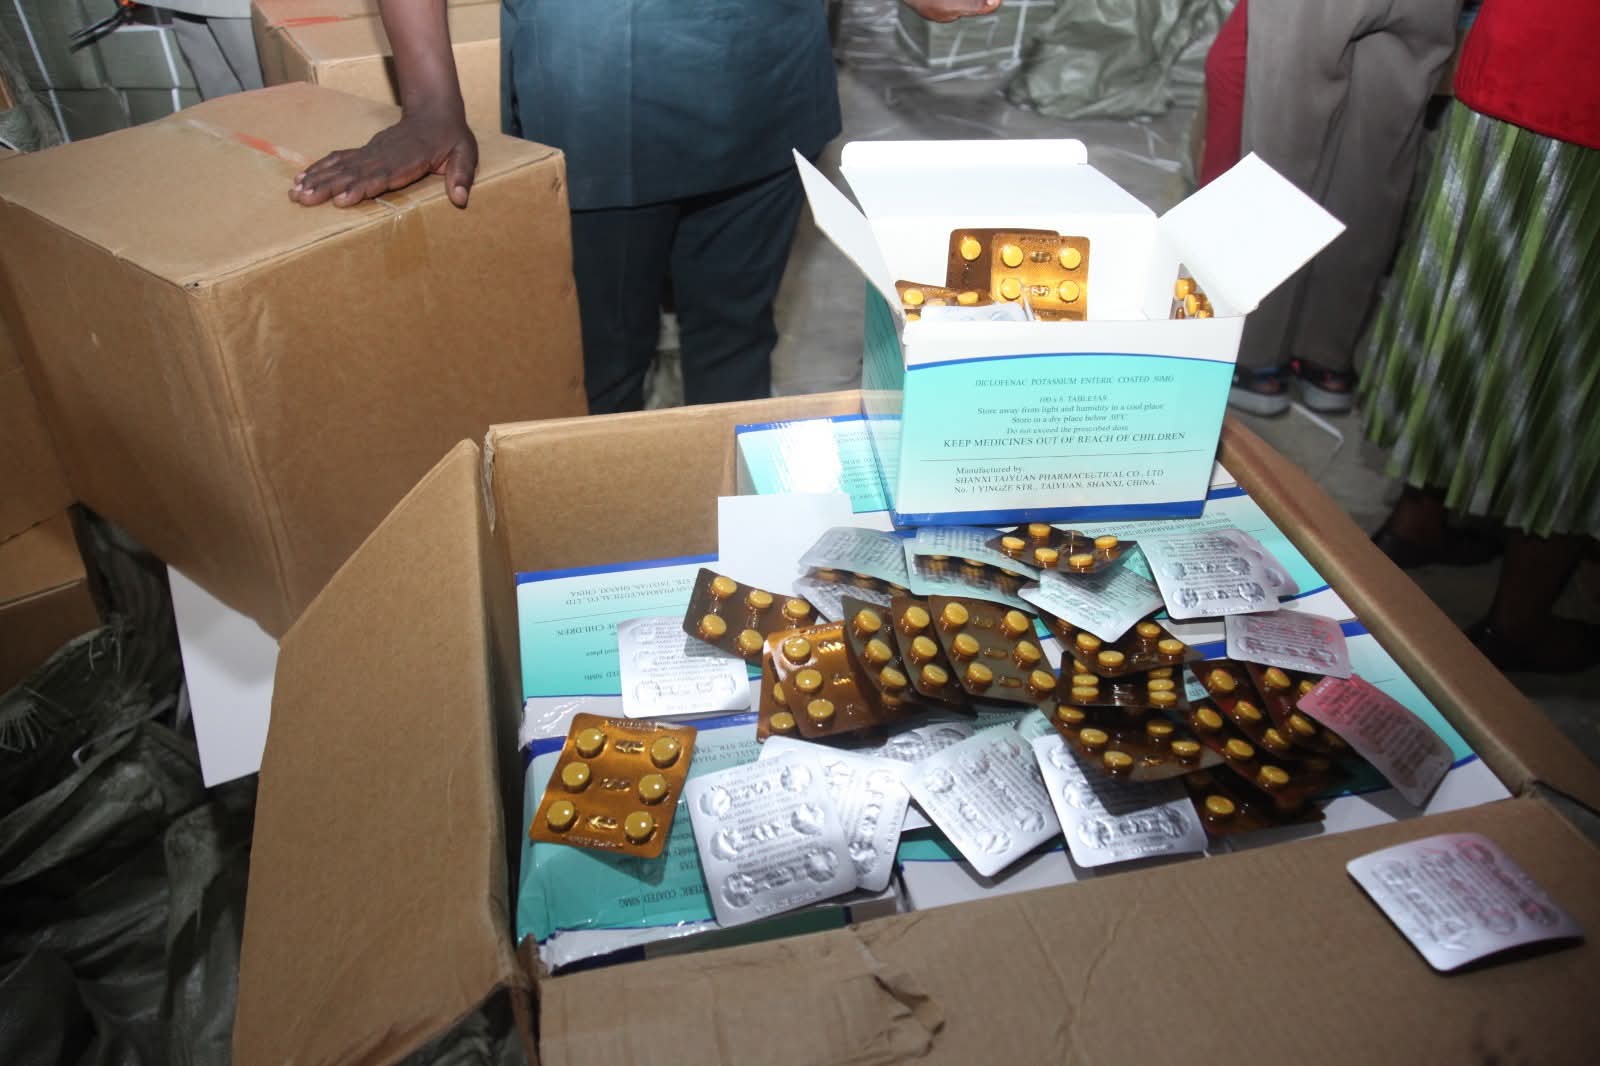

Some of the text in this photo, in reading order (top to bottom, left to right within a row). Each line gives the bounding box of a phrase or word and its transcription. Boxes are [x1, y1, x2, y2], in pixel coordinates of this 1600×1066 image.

[975, 378, 1025, 387] DICLOFENAC
[1031, 377, 1077, 386] POTASSIUM
[1080, 376, 1112, 385] ENTERIC
[1117, 375, 1150, 384] COATED
[977, 406, 996, 415] Store
[1021, 406, 1039, 414] from
[1041, 405, 1059, 414] light
[1061, 404, 1074, 413] and
[1076, 404, 1109, 413] humidity
[1127, 402, 1143, 411] cool
[1144, 402, 1164, 412] place
[1012, 416, 1032, 424] Store
[1048, 415, 1061, 424] dry
[1063, 415, 1083, 424] place
[1085, 413, 1107, 422] below
[1007, 427, 1018, 435] Do
[1033, 426, 1059, 435] exceed
[1061, 425, 1072, 433] the
[1073, 424, 1111, 433] prescribed
[943, 431, 1186, 448] KEEP MEDICINES OUT OF REACH OF CHILDREN
[956, 465, 1011, 475] Manufactured
[954, 475, 991, 485] SHANXI
[993, 473, 1036, 483] TAIYUAN
[1038, 470, 1123, 482] PHARMACEUTICAL
[978, 484, 1013, 493] YINGZE
[643, 888, 677, 903] COATED
